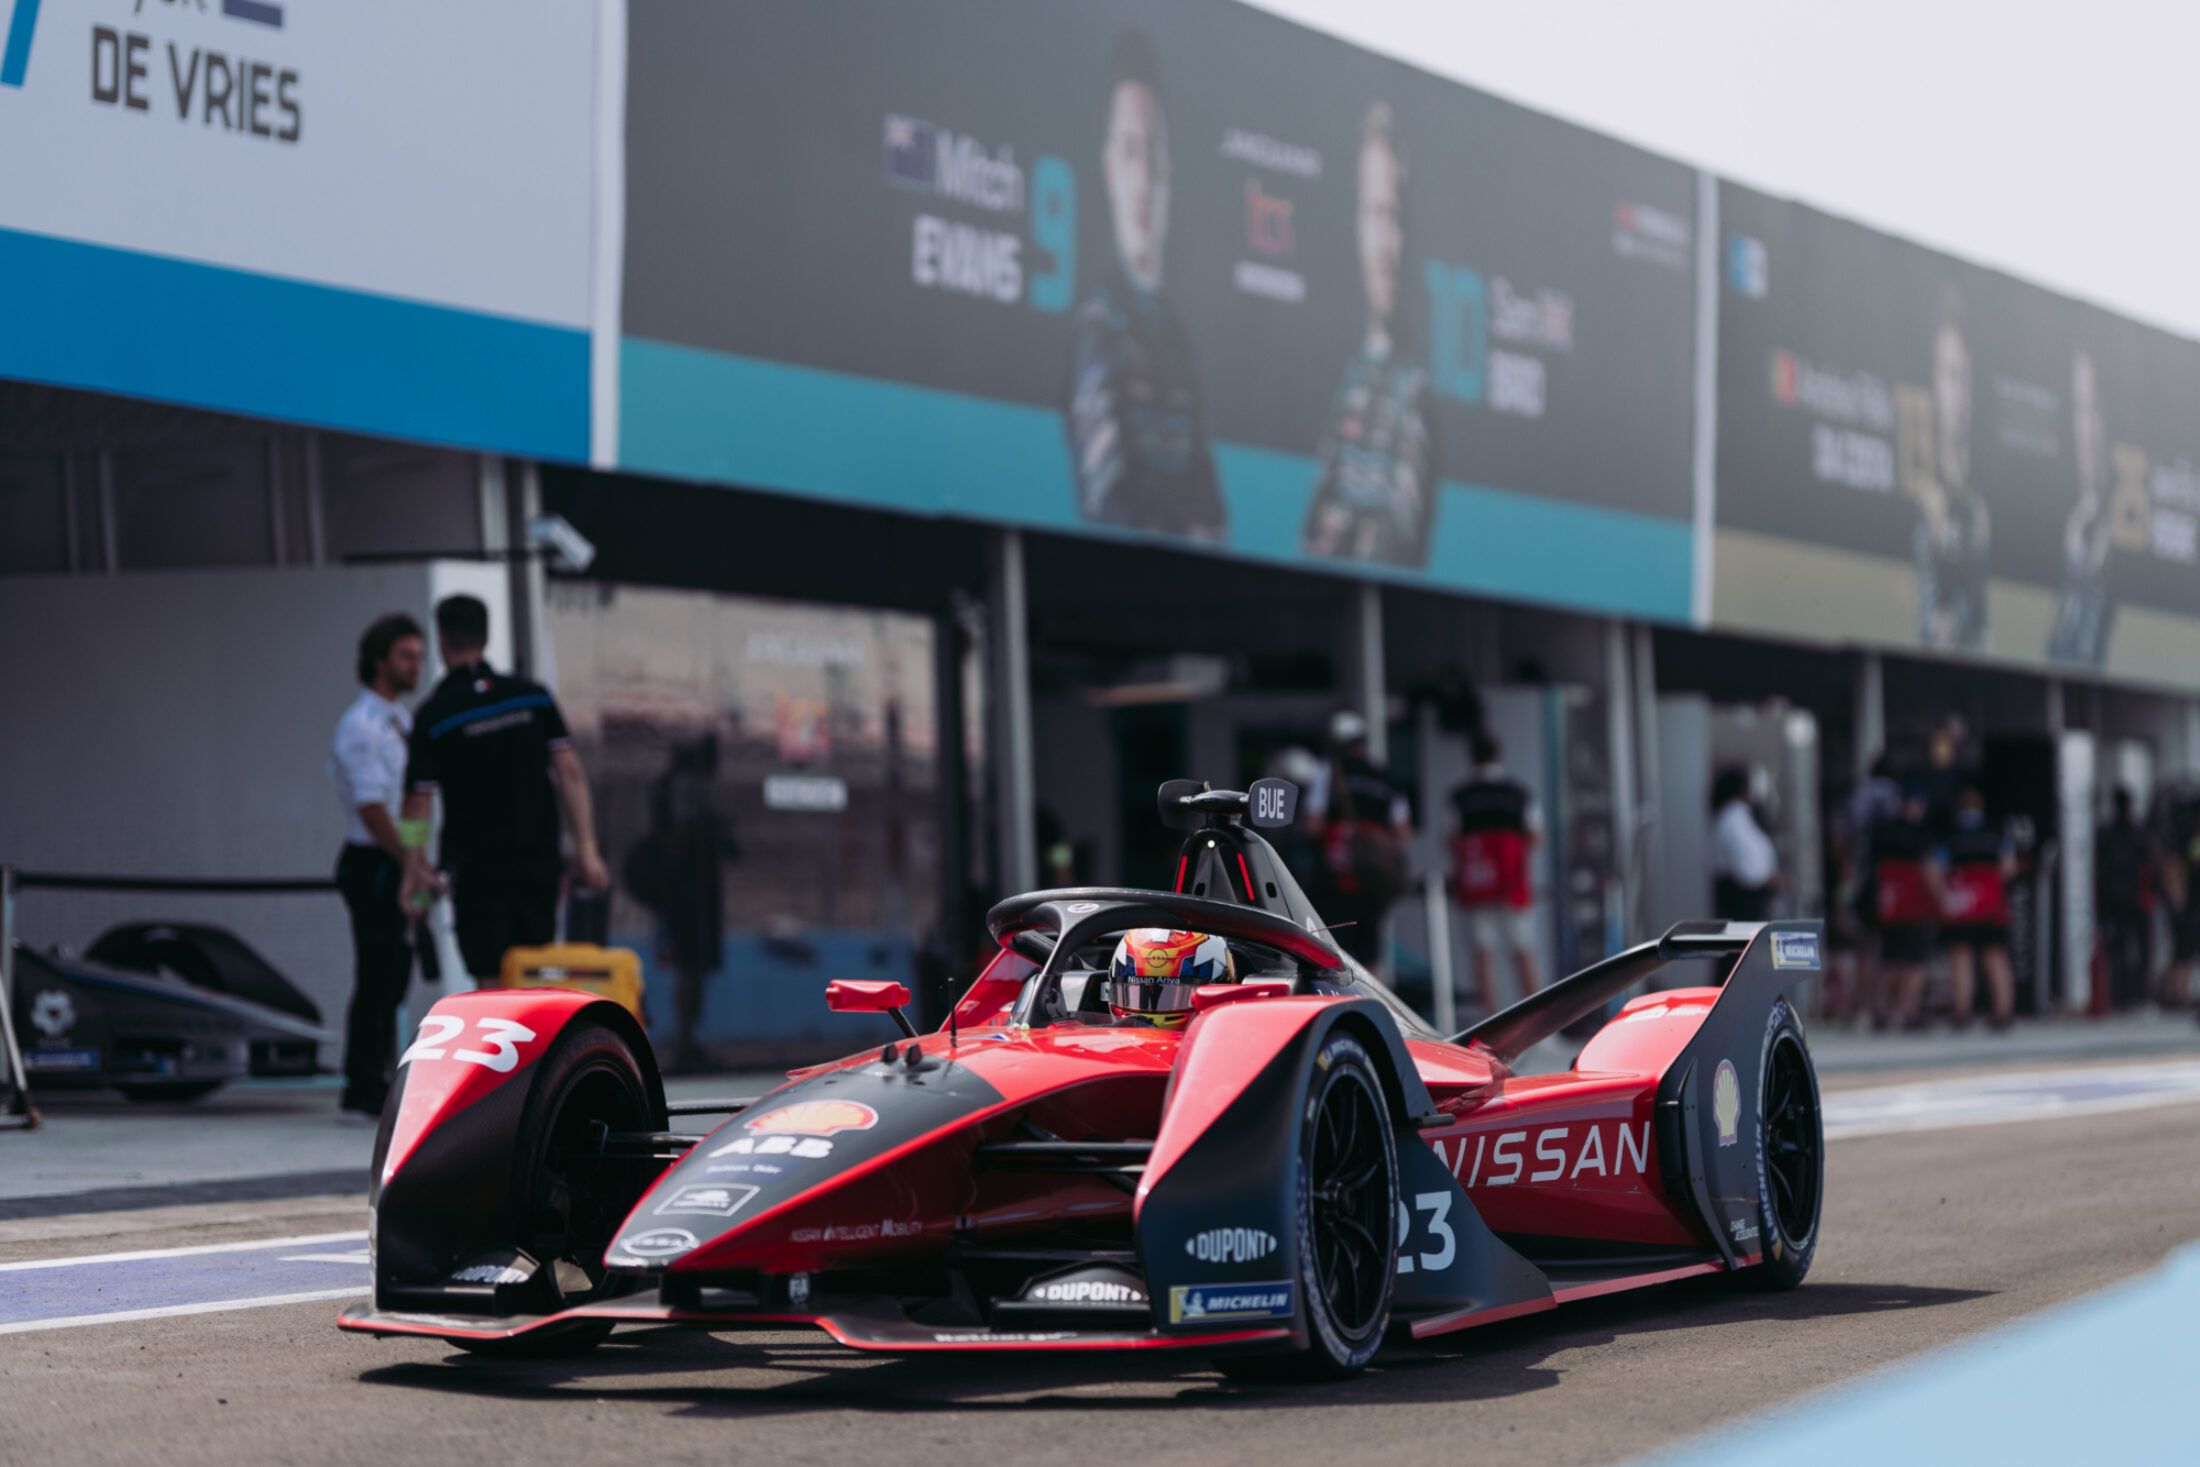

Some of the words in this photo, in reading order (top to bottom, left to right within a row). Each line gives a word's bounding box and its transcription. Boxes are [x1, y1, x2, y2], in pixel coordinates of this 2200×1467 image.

[92, 25, 150, 111] DE
[167, 41, 302, 143] VRIES
[1033, 155, 1077, 312] 9
[913, 214, 1022, 304] EVANS
[1258, 787, 1285, 819] BUE
[1127, 975, 1155, 984] Nissan
[1156, 975, 1181, 985] Ariya
[397, 1014, 537, 1073] 23
[708, 1136, 834, 1159] ABB
[1432, 1120, 1651, 1189] NISSAN
[1197, 1228, 1268, 1263] DUPONT
[1047, 1282, 1131, 1301] DUPONT
[1207, 1293, 1288, 1311] MICHELIN
